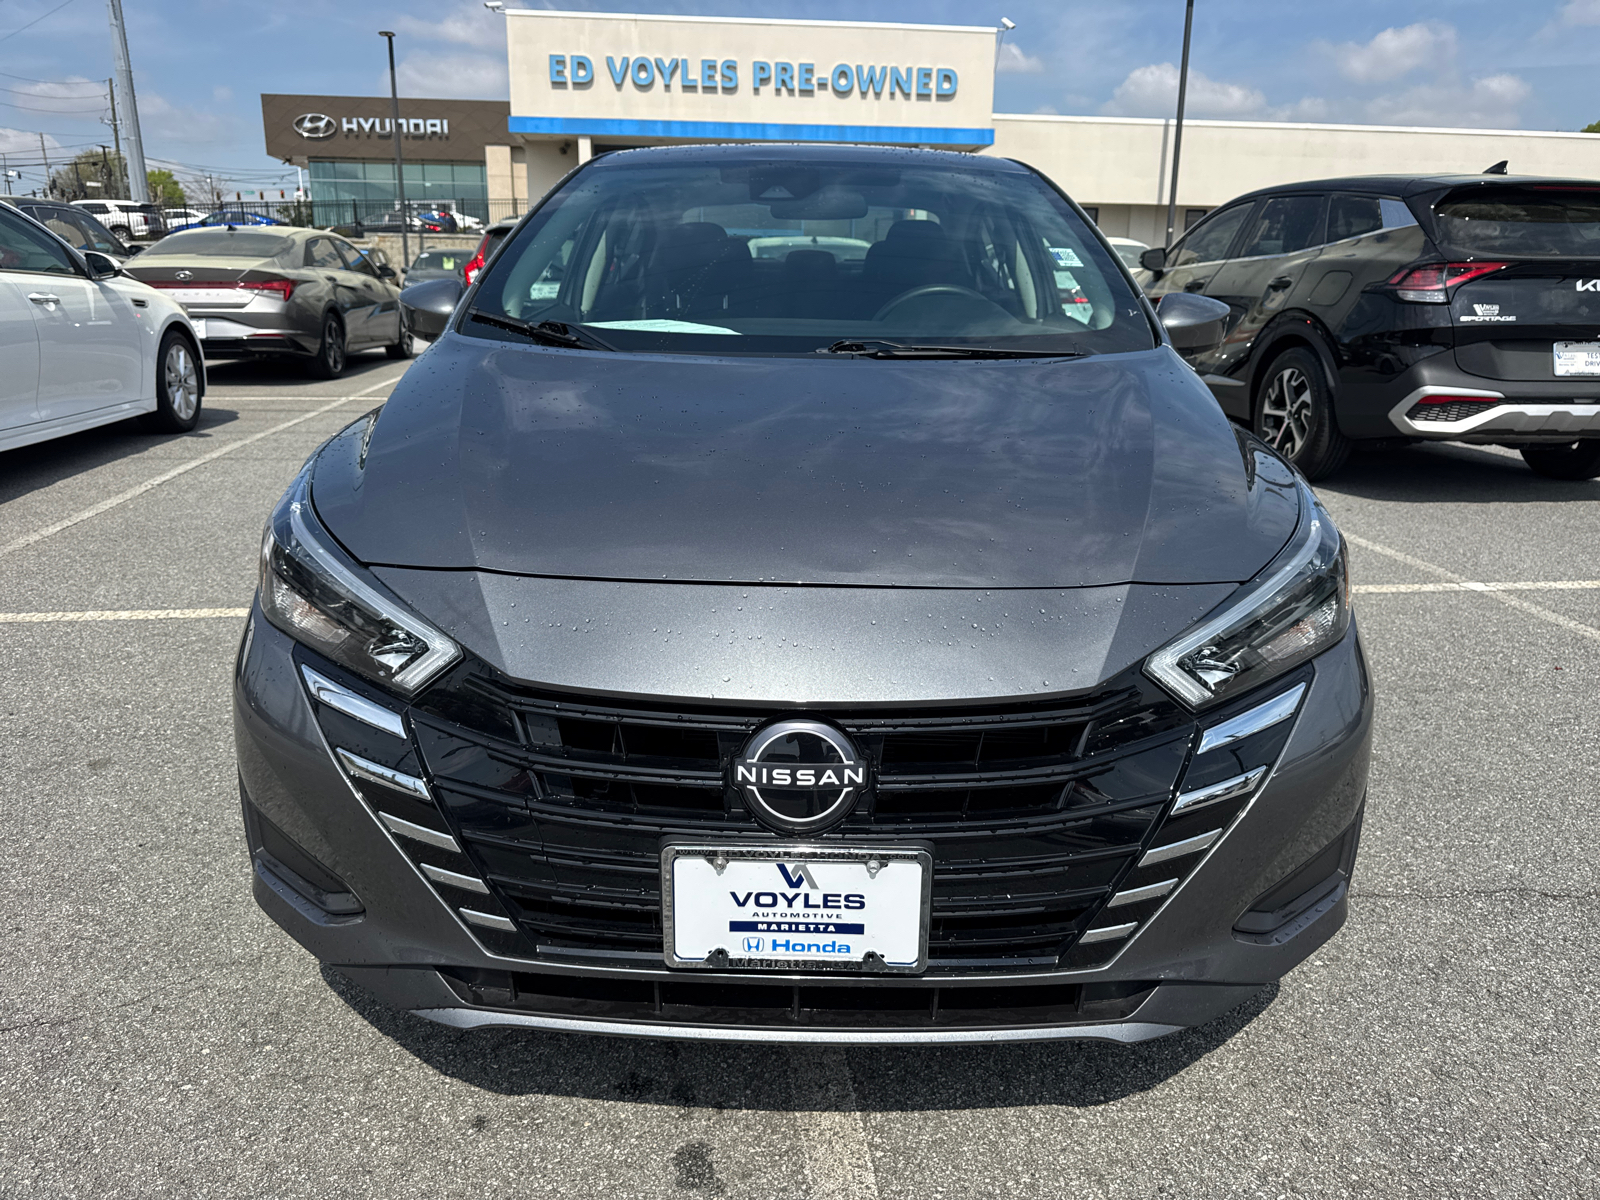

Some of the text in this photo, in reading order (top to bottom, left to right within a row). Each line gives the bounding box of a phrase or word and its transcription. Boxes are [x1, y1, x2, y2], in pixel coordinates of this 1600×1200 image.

[549, 54, 958, 96] ED VOYLES PRE-OWNED
[341, 117, 449, 135] HYUNDAI
[737, 765, 863, 786] NISSAN
[729, 891, 866, 910] VOYLES
[752, 911, 843, 919] AUTOMOTIVE
[757, 923, 836, 932] MARIETTA
[771, 938, 852, 954] Honda
